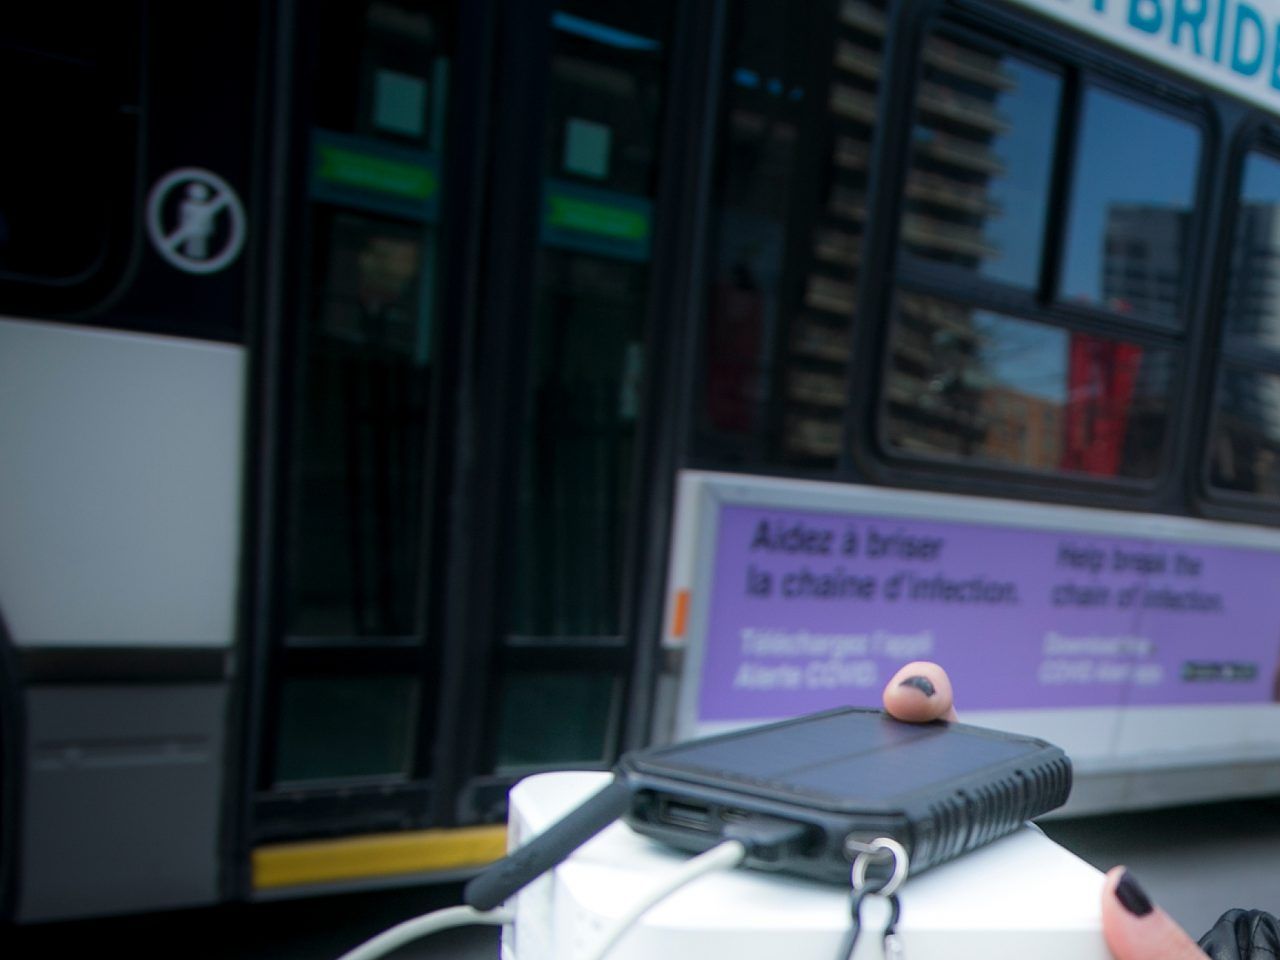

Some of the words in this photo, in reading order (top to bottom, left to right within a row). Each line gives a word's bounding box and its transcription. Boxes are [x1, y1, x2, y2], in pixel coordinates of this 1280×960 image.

[752, 519, 833, 554] Aidez
[842, 525, 858, 556] à
[865, 527, 944, 560] briser
[746, 565, 772, 597] la
[781, 567, 876, 599] chaîne
